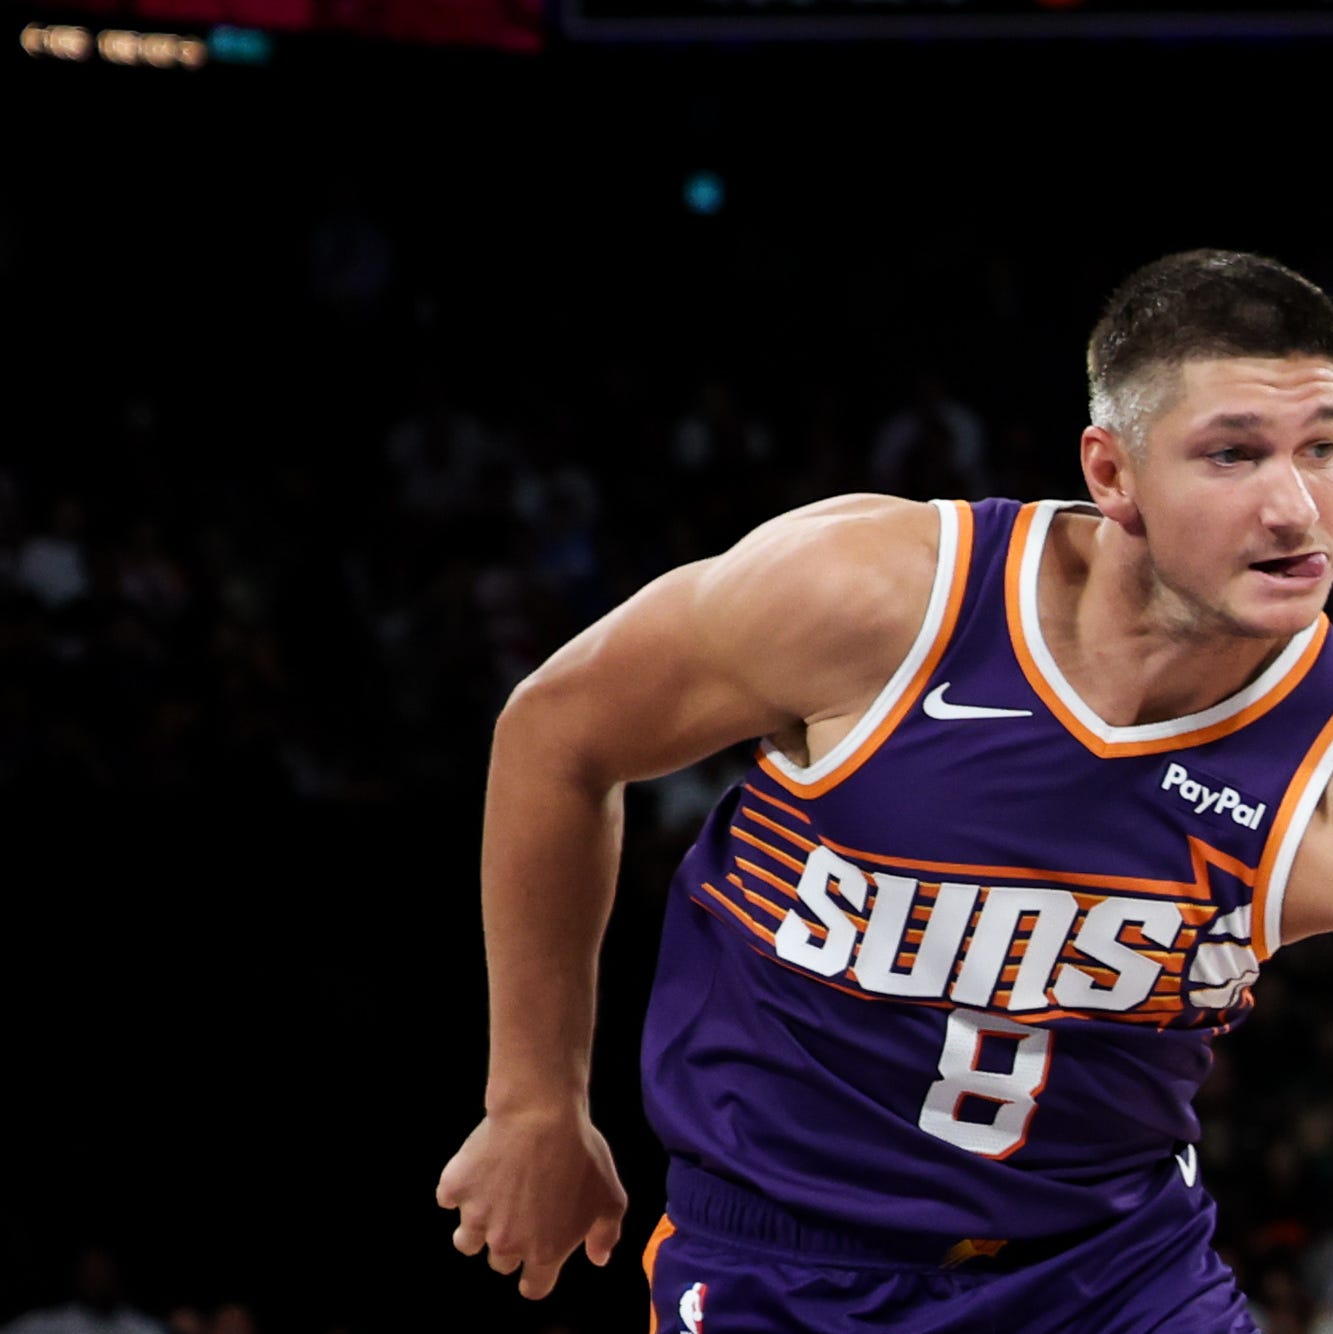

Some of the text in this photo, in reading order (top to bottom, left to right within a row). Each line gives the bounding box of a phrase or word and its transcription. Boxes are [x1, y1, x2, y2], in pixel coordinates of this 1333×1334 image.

[1161, 762, 1267, 831] PayPal
[775, 845, 1182, 1012] SUNS
[918, 1008, 1055, 1160] 8
